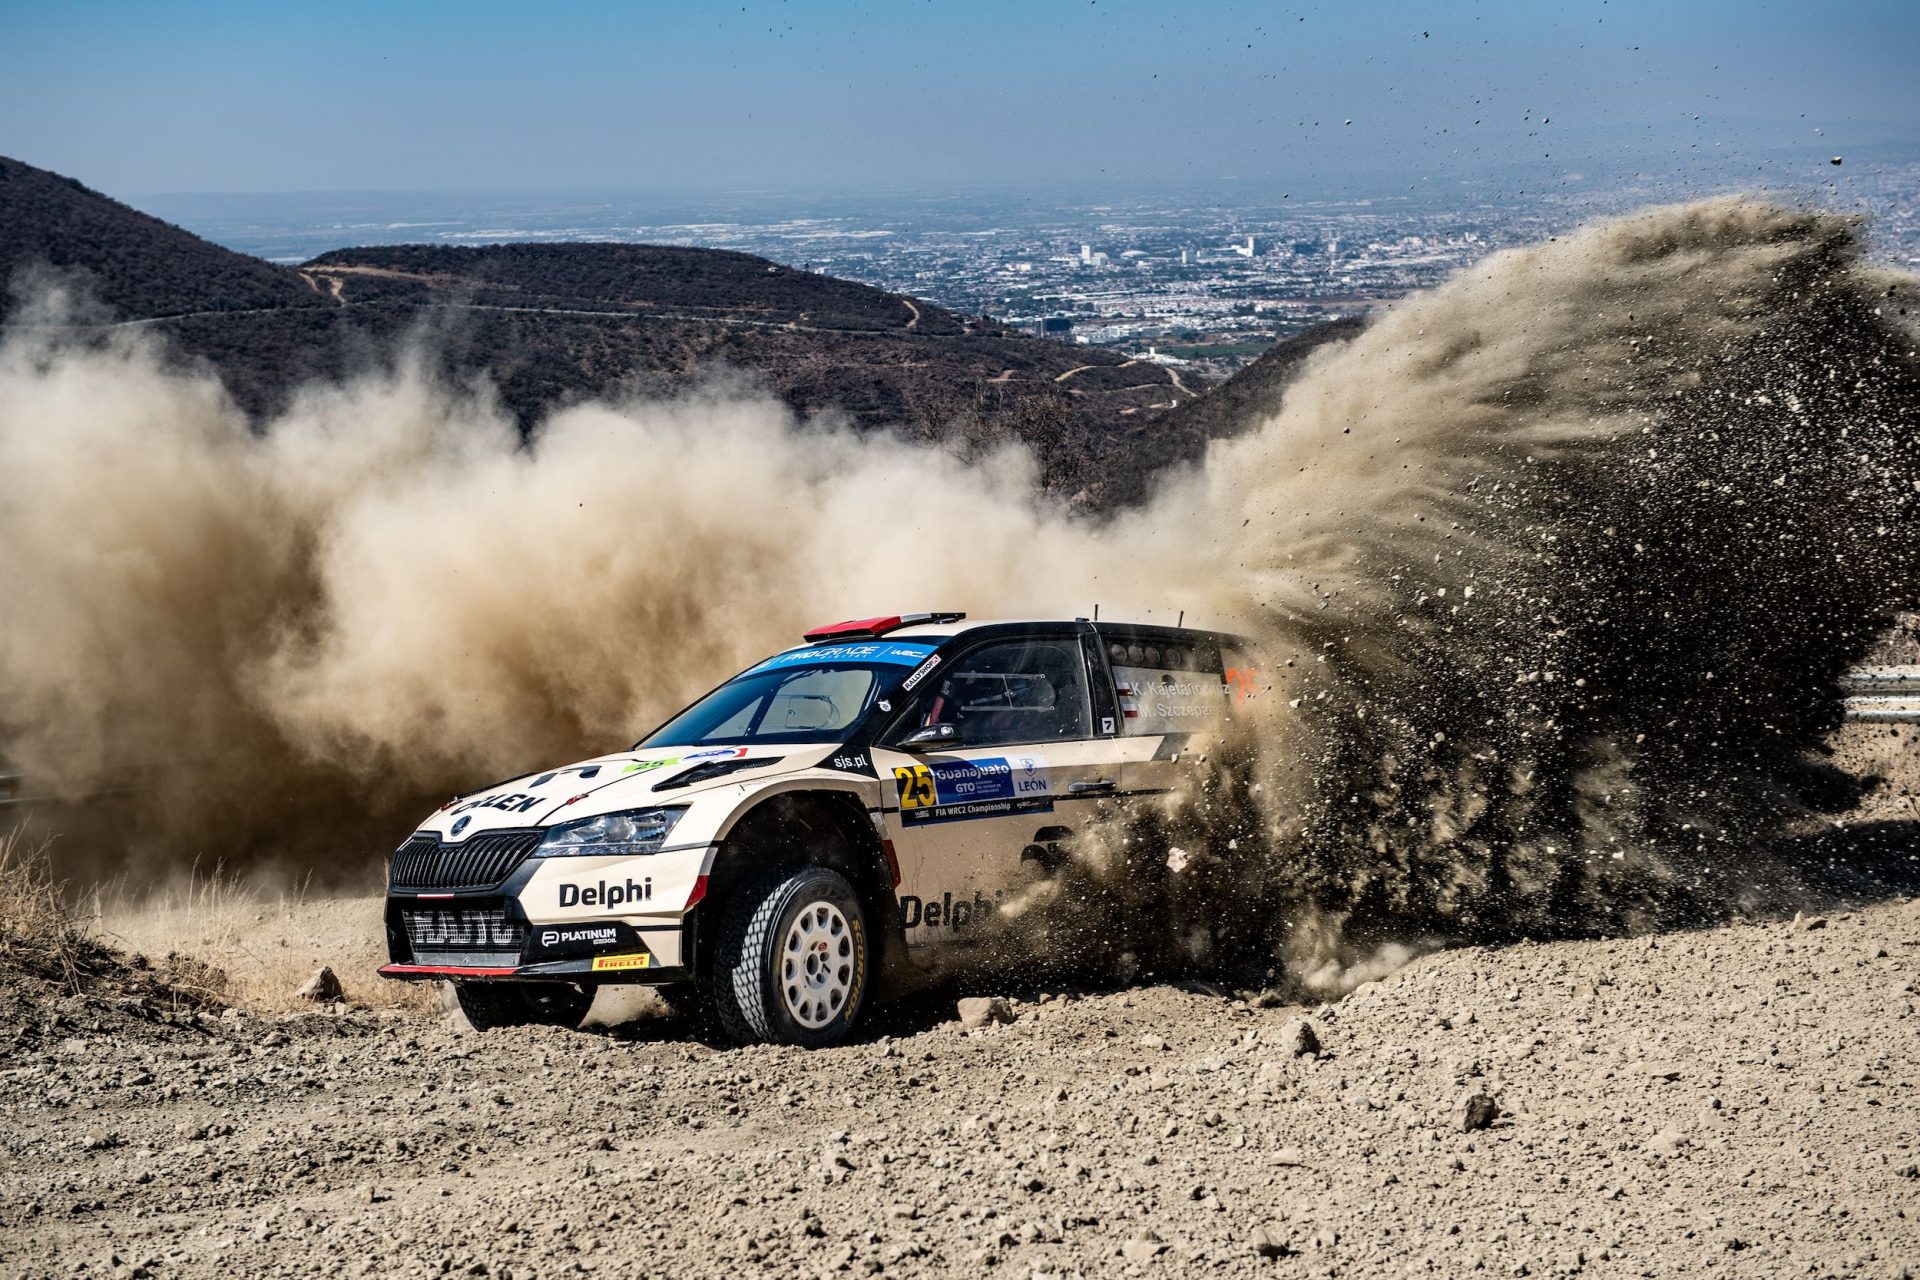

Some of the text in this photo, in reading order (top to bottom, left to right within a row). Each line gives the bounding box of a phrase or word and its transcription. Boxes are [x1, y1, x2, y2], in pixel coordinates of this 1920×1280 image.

[904, 660, 934, 690] RALLYSHOP
[1131, 682, 1146, 696] K.
[1137, 703, 1156, 718] M.
[1104, 720, 1112, 731] 7
[834, 754, 868, 769] sjs.pl
[937, 764, 1009, 780] Guanajuato
[894, 764, 936, 808] 25
[955, 782, 975, 793] GTO
[1018, 777, 1047, 791] LEÓN
[935, 807, 947, 816] FIA
[948, 804, 966, 815] WRC2
[967, 802, 1011, 814] Championship
[560, 877, 652, 909] Delphi
[561, 928, 617, 941] PLATINUM
